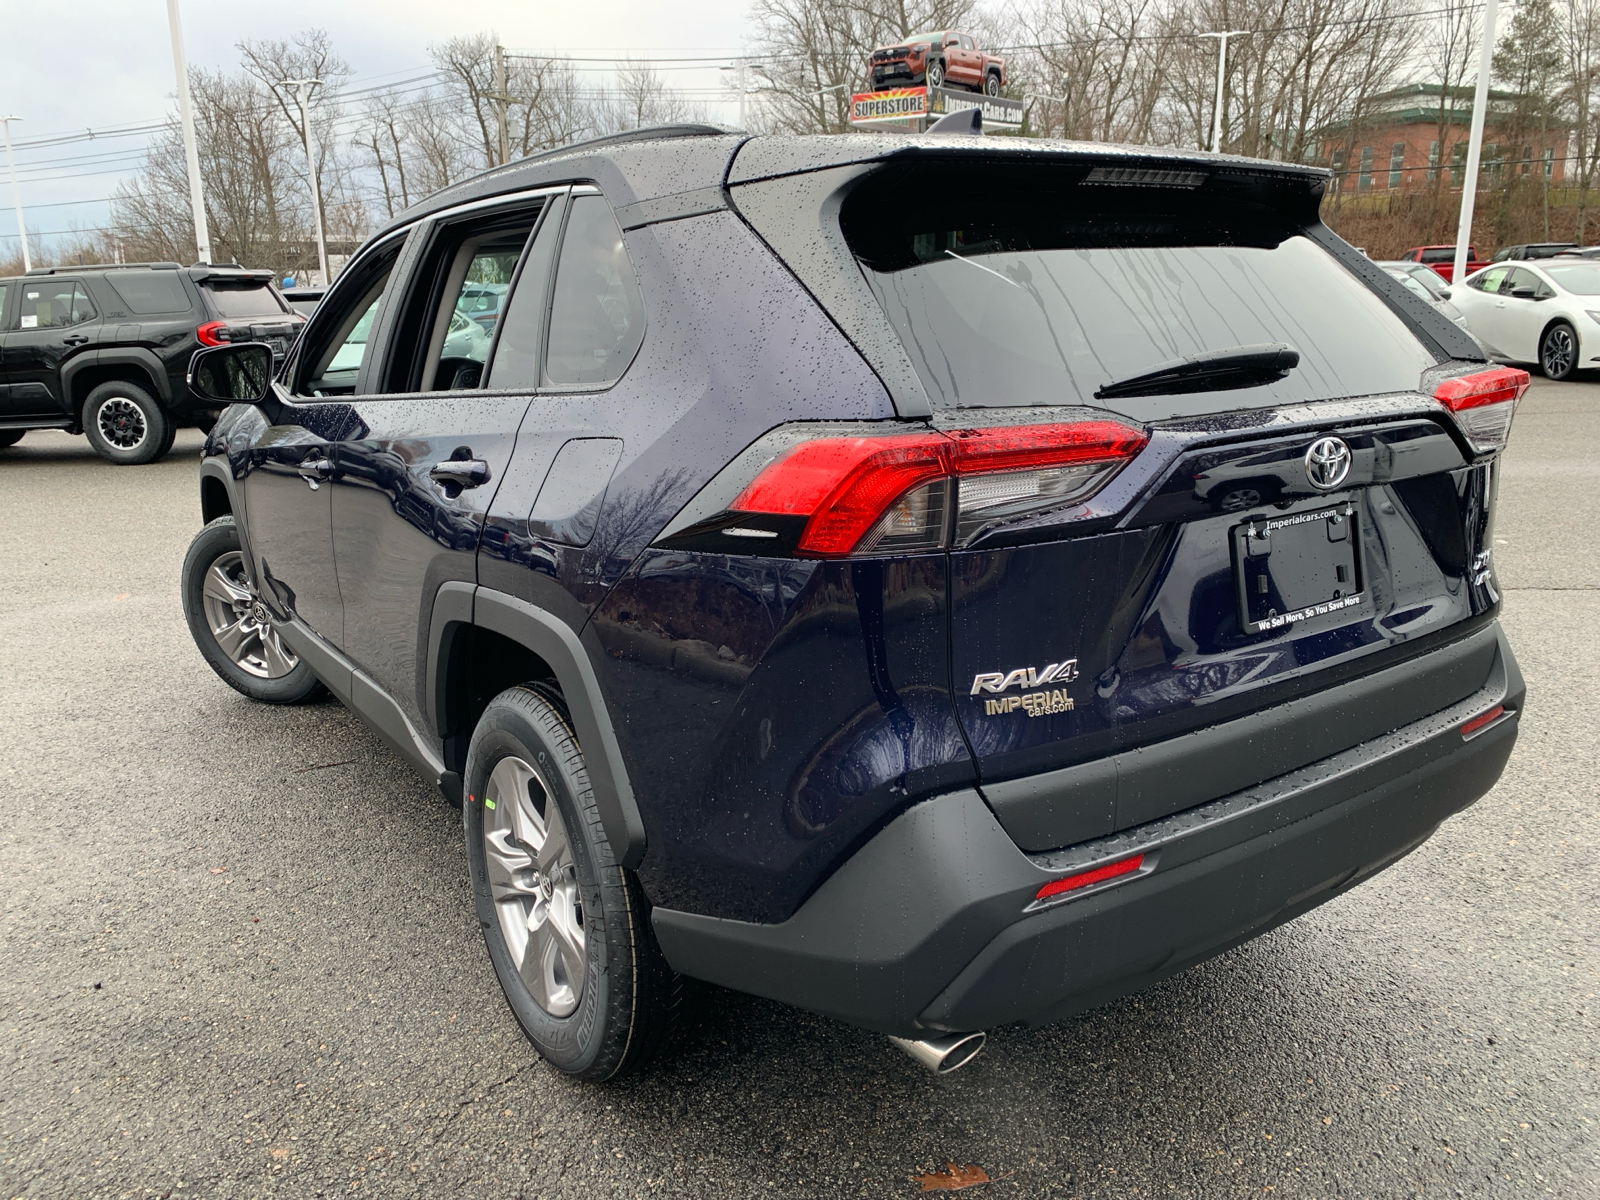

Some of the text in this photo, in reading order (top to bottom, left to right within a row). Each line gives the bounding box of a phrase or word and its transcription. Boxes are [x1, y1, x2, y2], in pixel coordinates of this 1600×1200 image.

[854, 95, 923, 118] SUPERSTORE
[1266, 509, 1337, 530] Imperialcars.com
[1258, 596, 1360, 631] We Sell More, So You Save More
[970, 659, 1079, 695] RAV4
[985, 688, 1074, 716] IMPERIAL
[1028, 701, 1075, 718] cars.com
